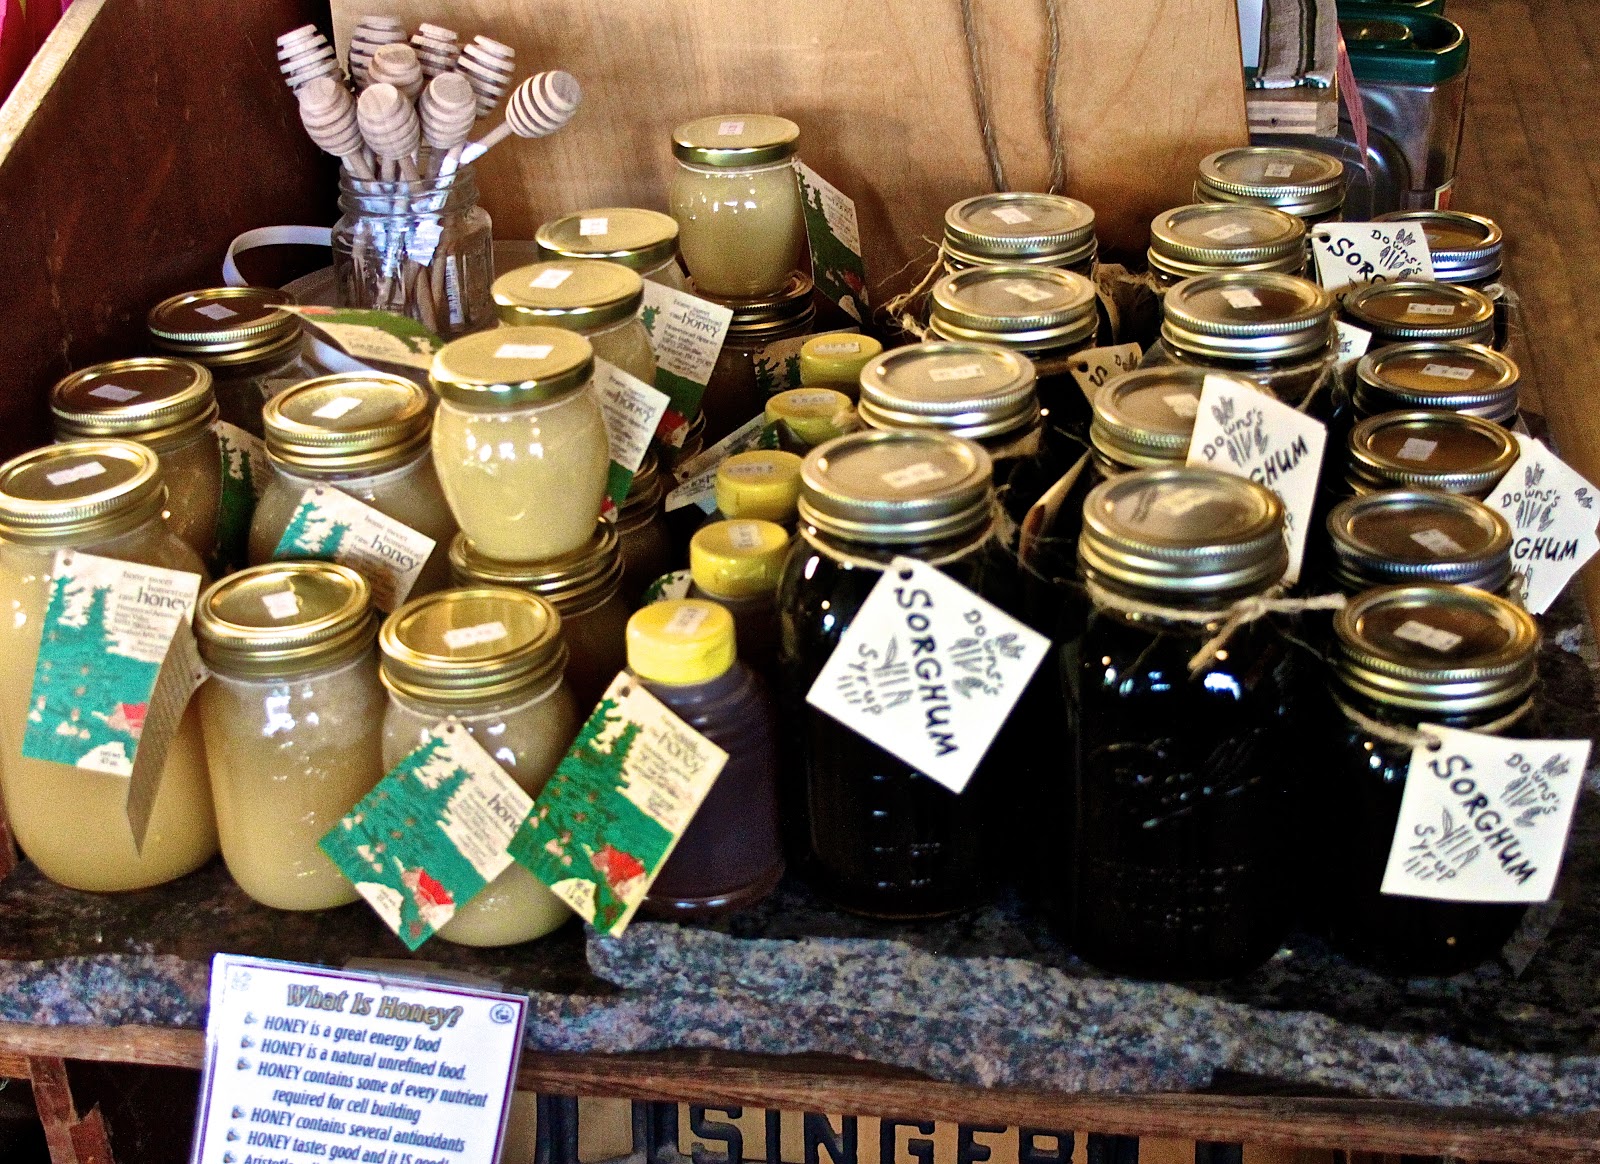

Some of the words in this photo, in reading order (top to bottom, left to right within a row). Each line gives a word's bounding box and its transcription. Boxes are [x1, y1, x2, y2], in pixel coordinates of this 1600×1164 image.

[1250, 434, 1309, 485] GHUM
[1511, 537, 1579, 562] GHUM
[894, 587, 960, 757] SORGHUM
[487, 794, 521, 833] hon
[1427, 754, 1538, 886] SORGHUM
[287, 984, 349, 1012] What
[350, 992, 375, 1016] Is
[376, 996, 464, 1031] Honey?
[264, 1015, 309, 1034] HONEY
[310, 1020, 321, 1036] is
[323, 1025, 332, 1037] a
[333, 1027, 368, 1042] great
[370, 1032, 412, 1051] energy
[413, 1034, 442, 1052] food
[261, 1038, 306, 1057] HONEY
[307, 1043, 318, 1059] is
[320, 1048, 328, 1060] a
[331, 1050, 377, 1067] natural
[378, 1056, 437, 1076] unrefined
[438, 1061, 467, 1080] food.
[258, 1061, 302, 1080] HONEY
[303, 1070, 354, 1088] contains
[356, 1077, 388, 1093] some
[390, 1079, 405, 1094] of
[405, 1084, 438, 1103] every
[440, 1089, 488, 1107] nutrient
[272, 1089, 326, 1107] required
[327, 1093, 345, 1110] for
[347, 1097, 370, 1113] cell
[371, 1099, 421, 1125] building
[247, 1130, 291, 1149] HONEY
[292, 1138, 328, 1155] tastes
[328, 1145, 362, 1161] good
[362, 1149, 387, 1163] and
[388, 1150, 398, 1164] it
[251, 1107, 295, 1126] HONEY
[296, 1117, 347, 1134] contains
[349, 1123, 392, 1141] several
[393, 1129, 466, 1153] antioxidants
